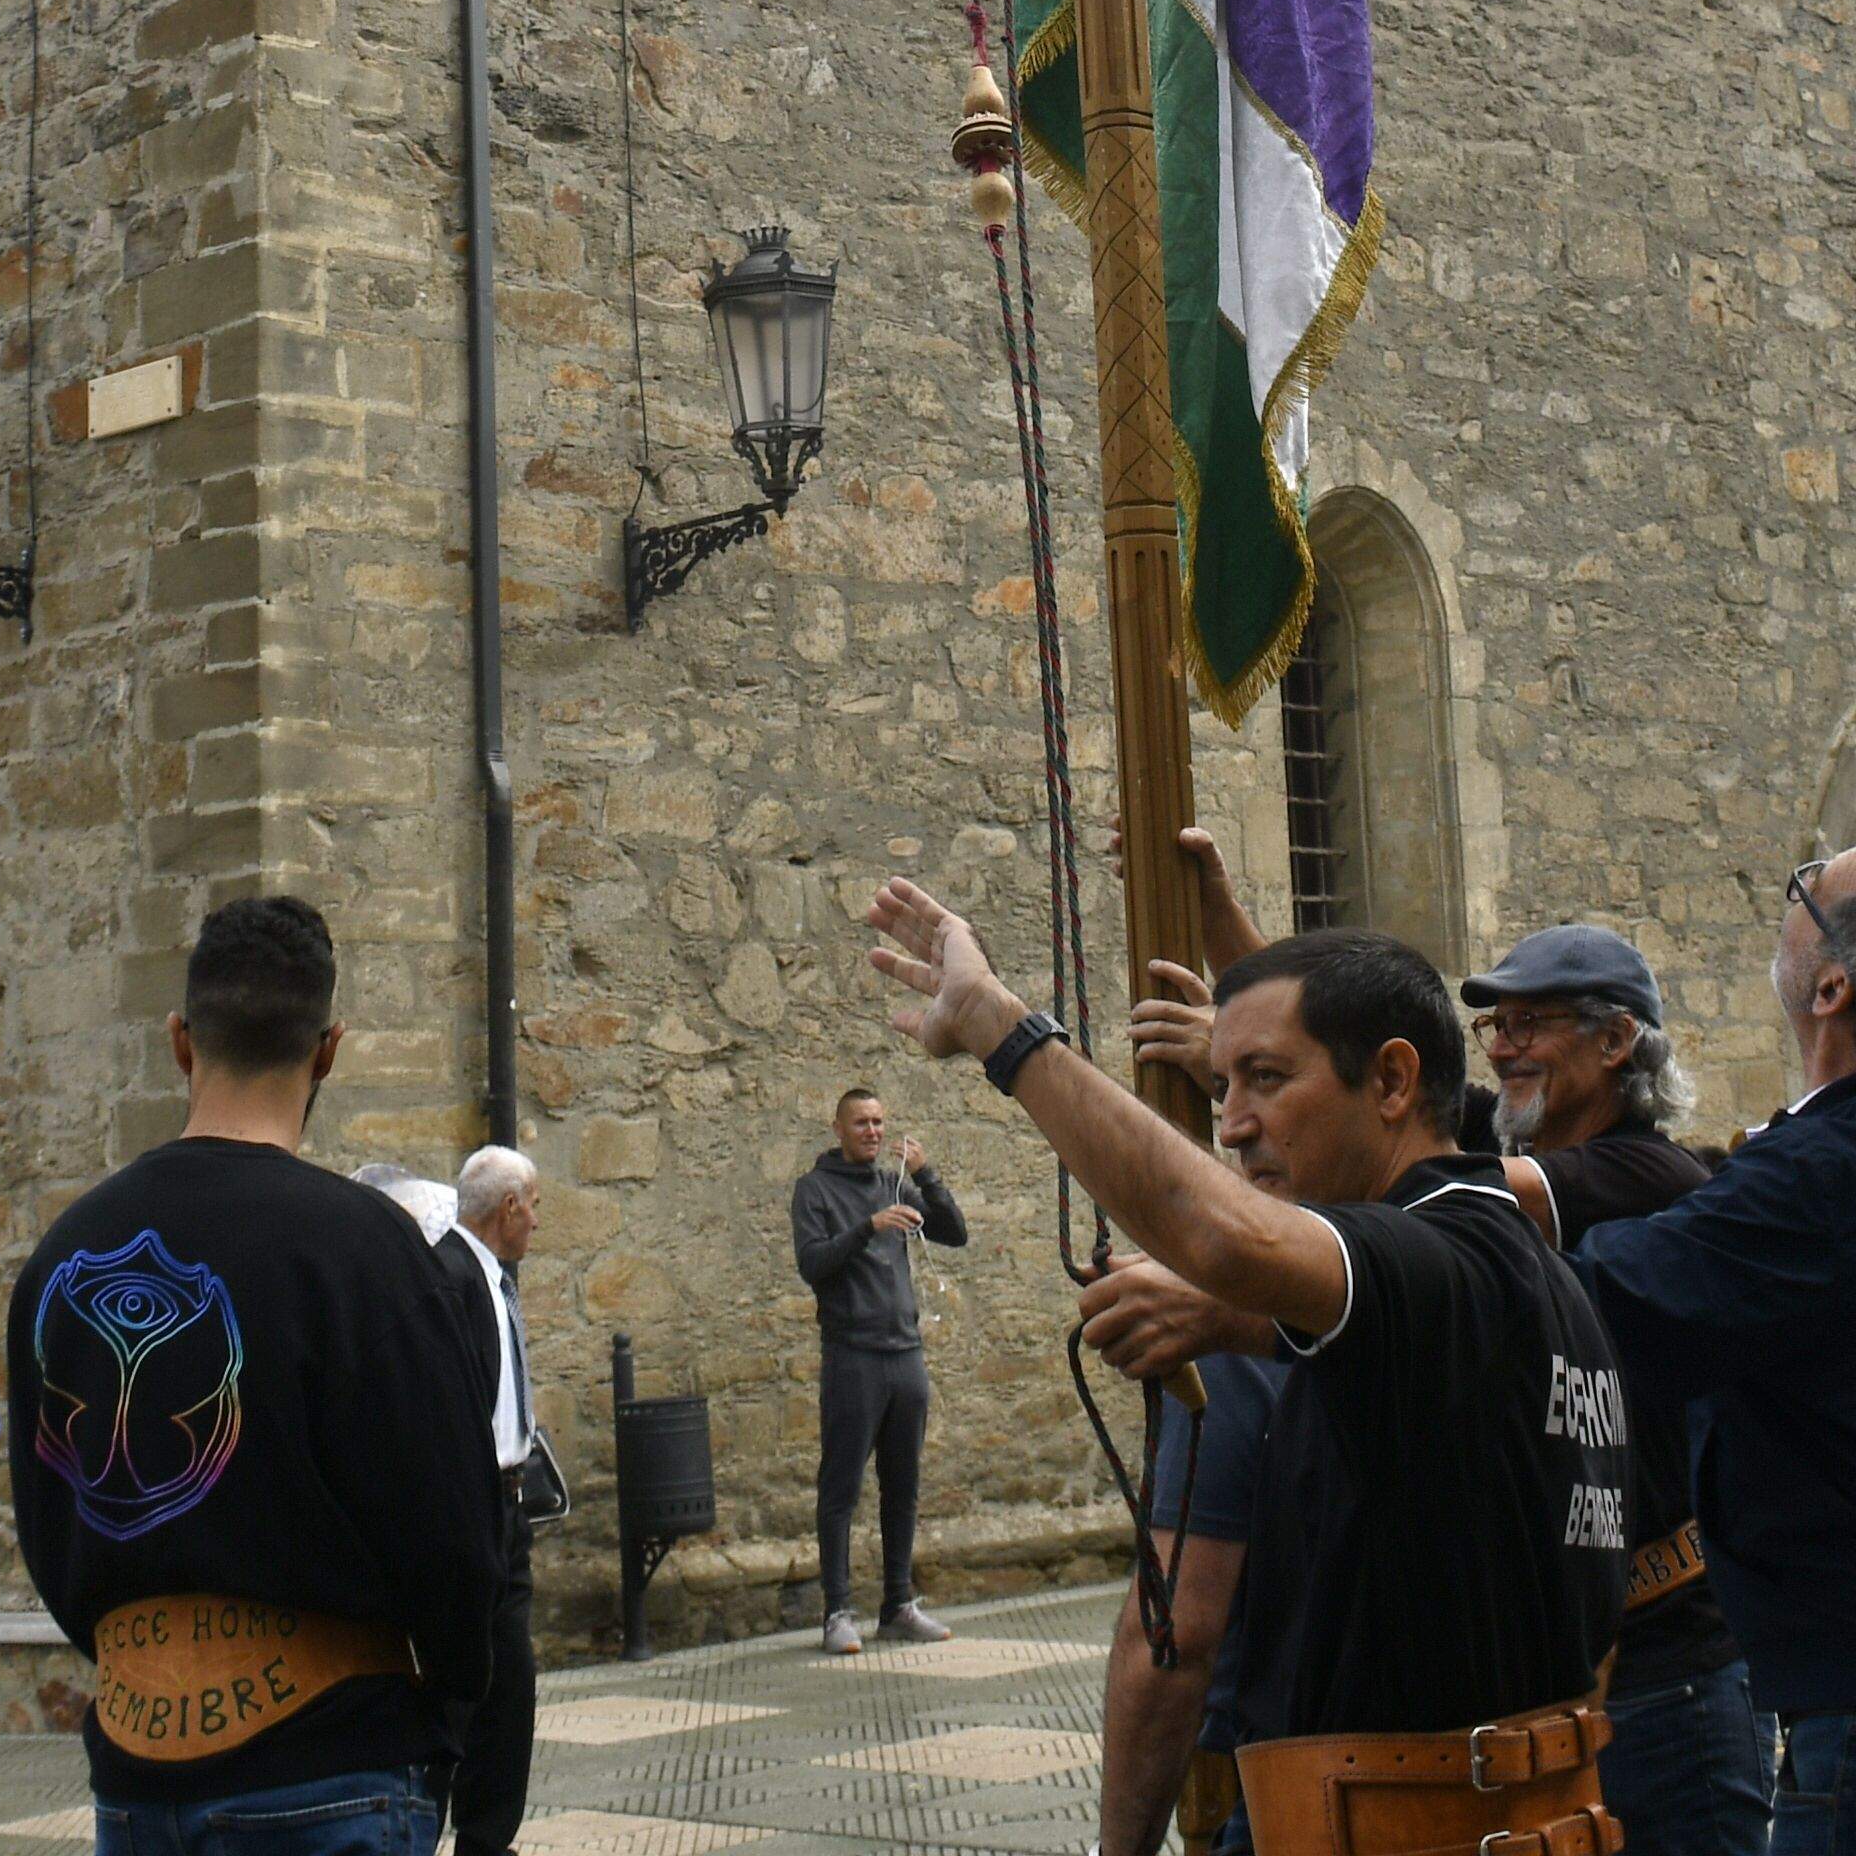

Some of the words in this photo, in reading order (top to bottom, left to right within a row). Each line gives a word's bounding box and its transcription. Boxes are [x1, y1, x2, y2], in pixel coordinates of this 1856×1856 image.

[101, 1610, 170, 1654] ECCE
[192, 1603, 297, 1642] HOMO
[97, 1655, 297, 1741] BEMBIBRE
